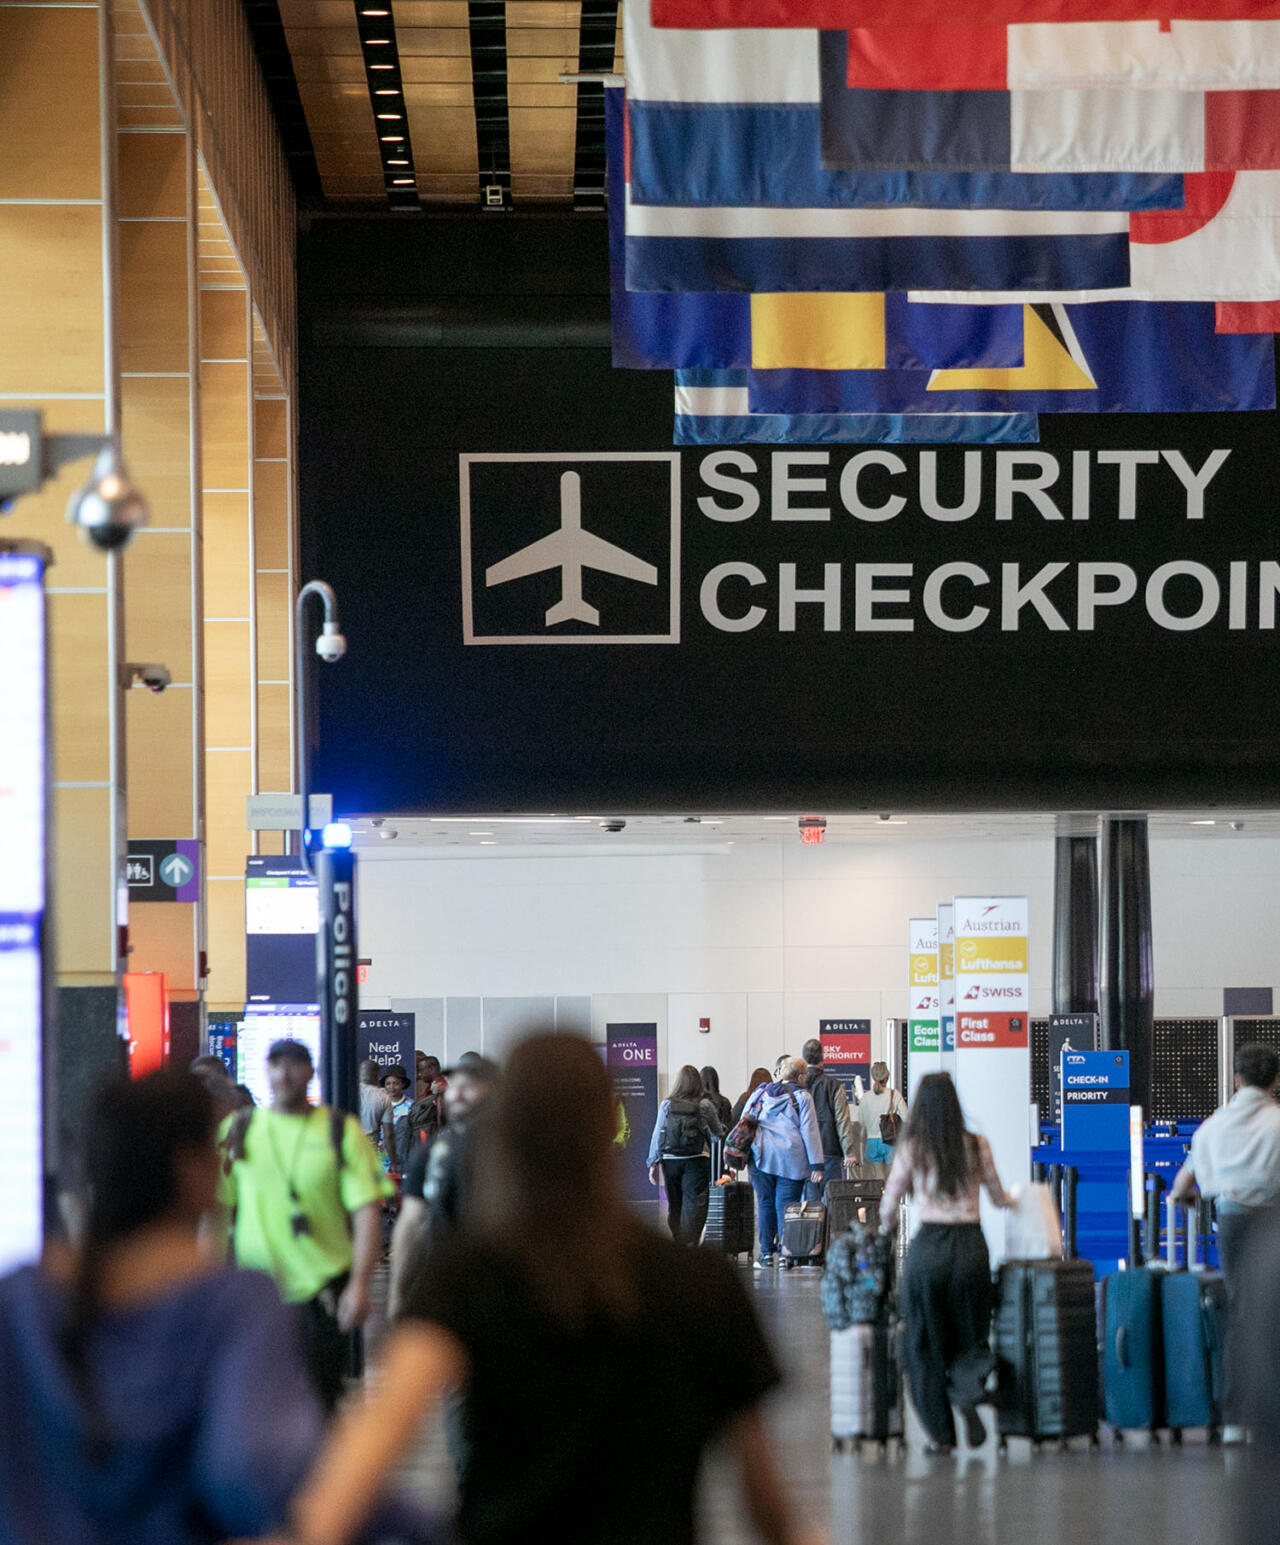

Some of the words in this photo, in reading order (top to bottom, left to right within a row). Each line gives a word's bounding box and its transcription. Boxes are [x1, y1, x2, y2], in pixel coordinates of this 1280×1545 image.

[696, 448, 1232, 523] SECURITY
[802, 828, 823, 844] EXIT
[962, 919, 1021, 931] Austrian
[333, 882, 350, 1024] Police
[960, 958, 1023, 970] Lufthansa
[982, 987, 1022, 998] SWISS
[369, 1020, 400, 1028] DELTA
[961, 1017, 989, 1029] First
[961, 1031, 995, 1042] Class
[369, 1042, 400, 1053] Need
[623, 1049, 652, 1060] ONE
[824, 1052, 864, 1060] PRIORITY
[1067, 1076, 1109, 1085] CHECK-IN
[1067, 1091, 1108, 1101] PRIORITY
